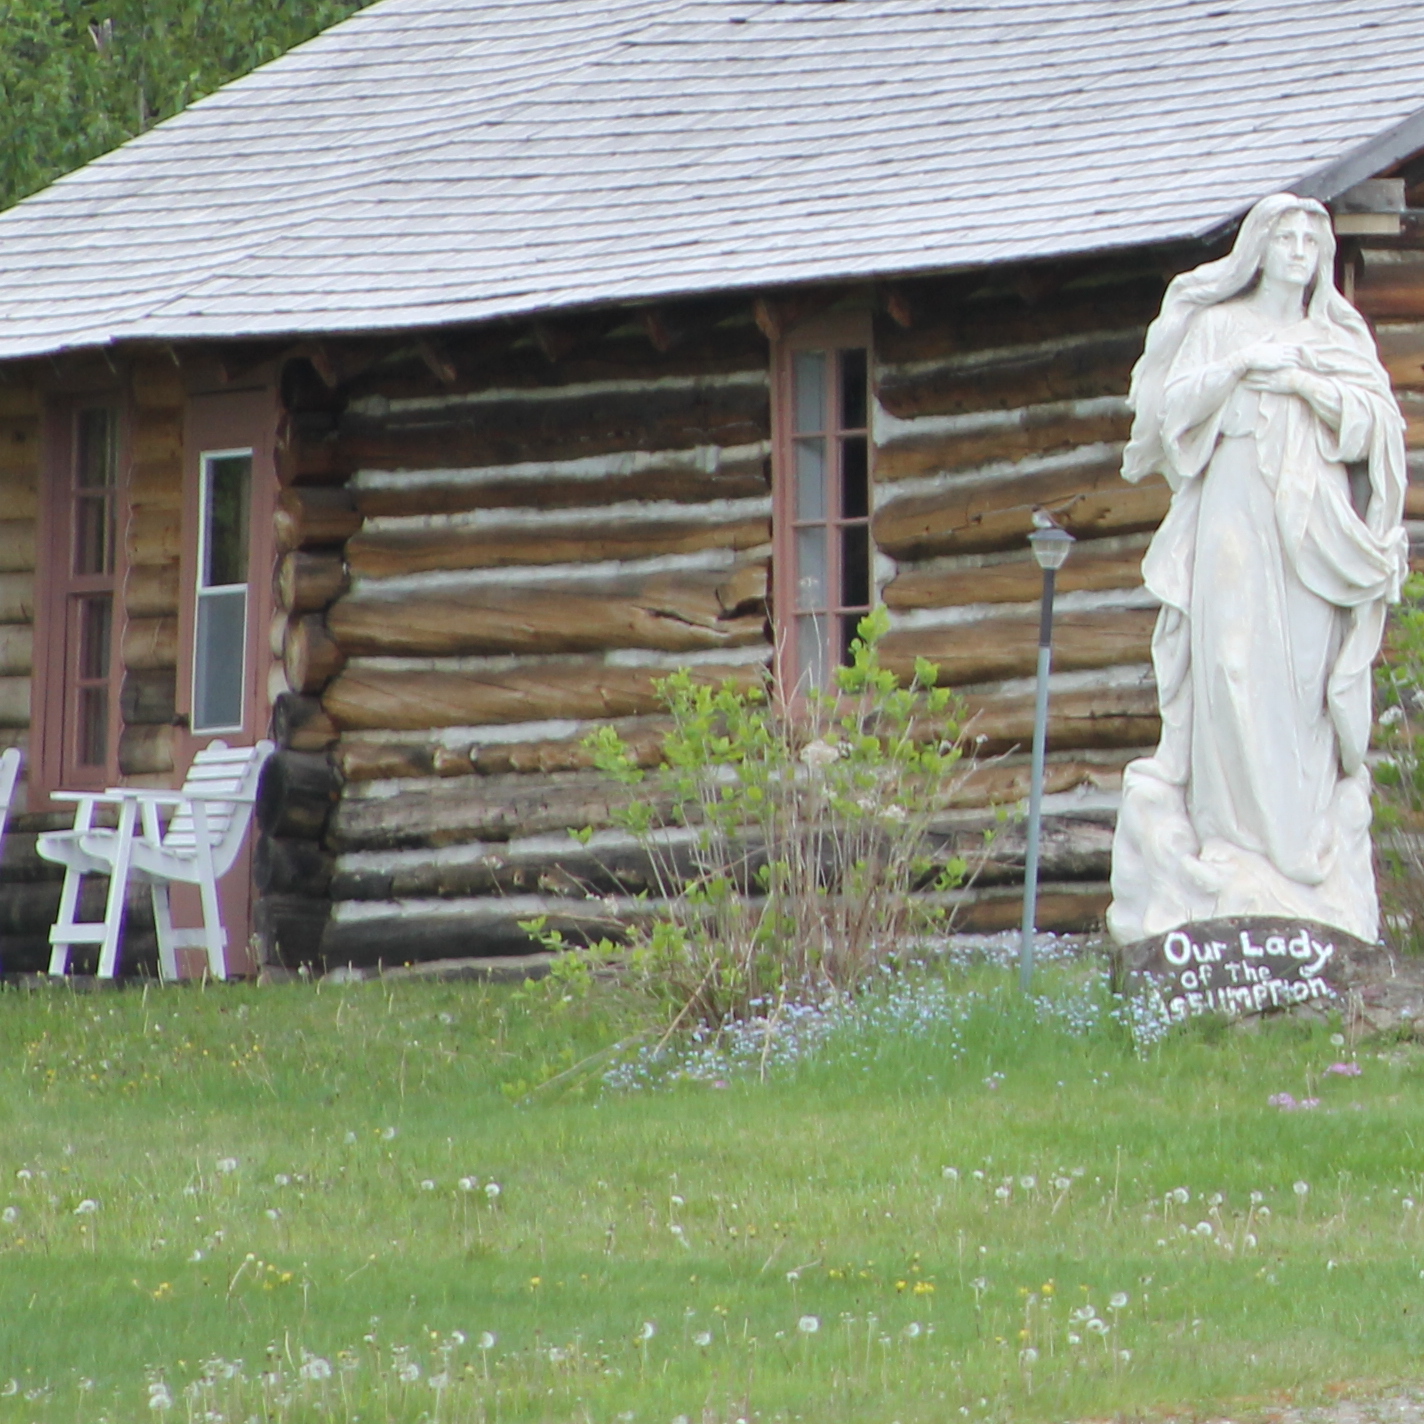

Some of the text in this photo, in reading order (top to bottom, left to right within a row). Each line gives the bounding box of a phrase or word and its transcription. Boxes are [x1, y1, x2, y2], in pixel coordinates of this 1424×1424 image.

[1164, 928, 1335, 979] Our Lady
[1180, 964, 1213, 990] of
